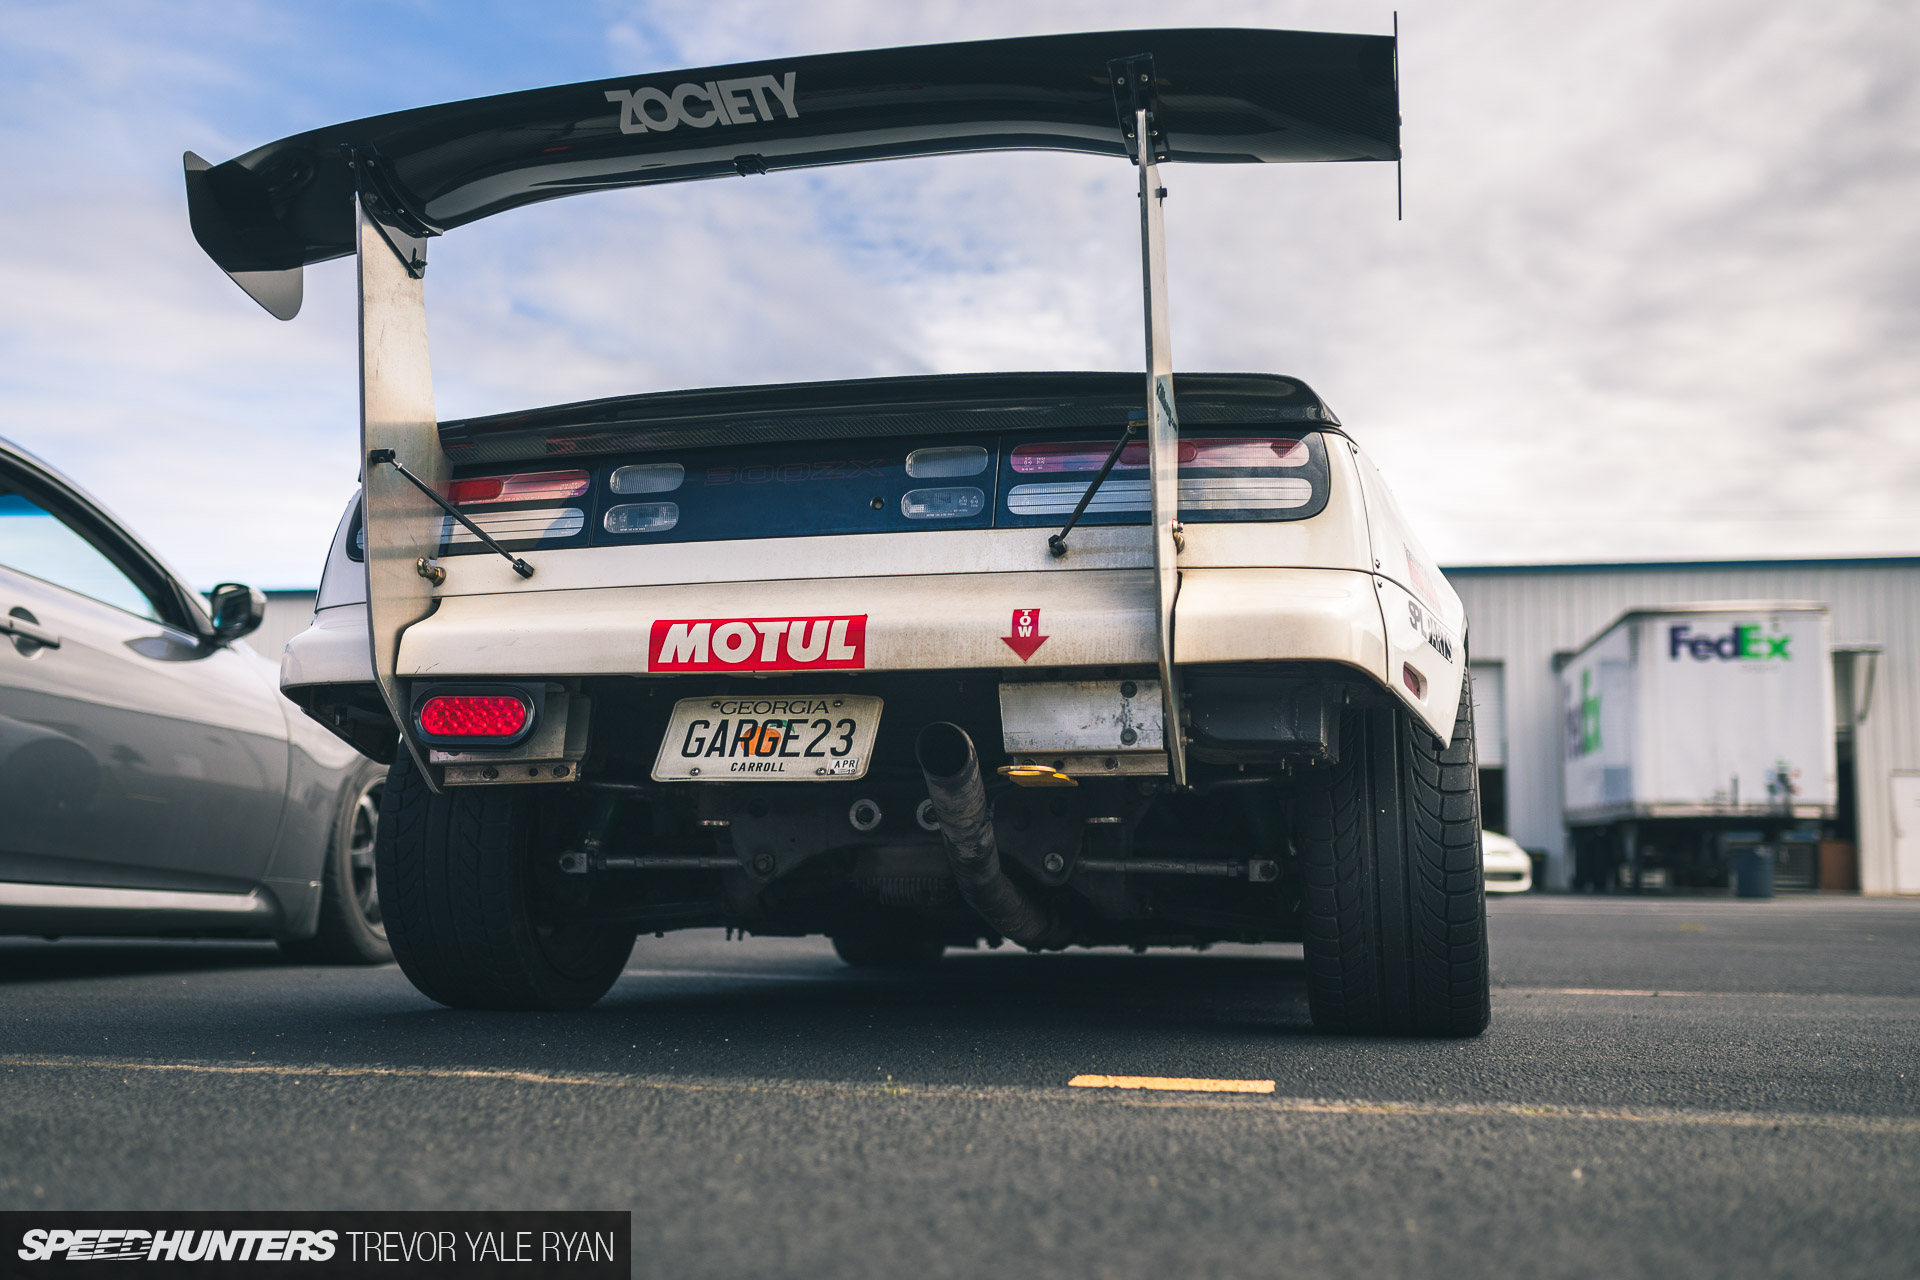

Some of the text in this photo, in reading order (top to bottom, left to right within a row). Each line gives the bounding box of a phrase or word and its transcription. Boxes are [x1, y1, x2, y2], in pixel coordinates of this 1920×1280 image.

[604, 71, 799, 135] ZOCIETY
[704, 458, 885, 486] 300ZX
[1018, 609, 1033, 638] TOW
[1408, 600, 1427, 640] SPL
[657, 619, 857, 664] MOTUL
[1669, 624, 1792, 661] FedEx
[720, 701, 829, 715] GEORGIA
[681, 718, 857, 758] GARGE23
[730, 762, 786, 772] CARROLL
[834, 760, 856, 768] APR
